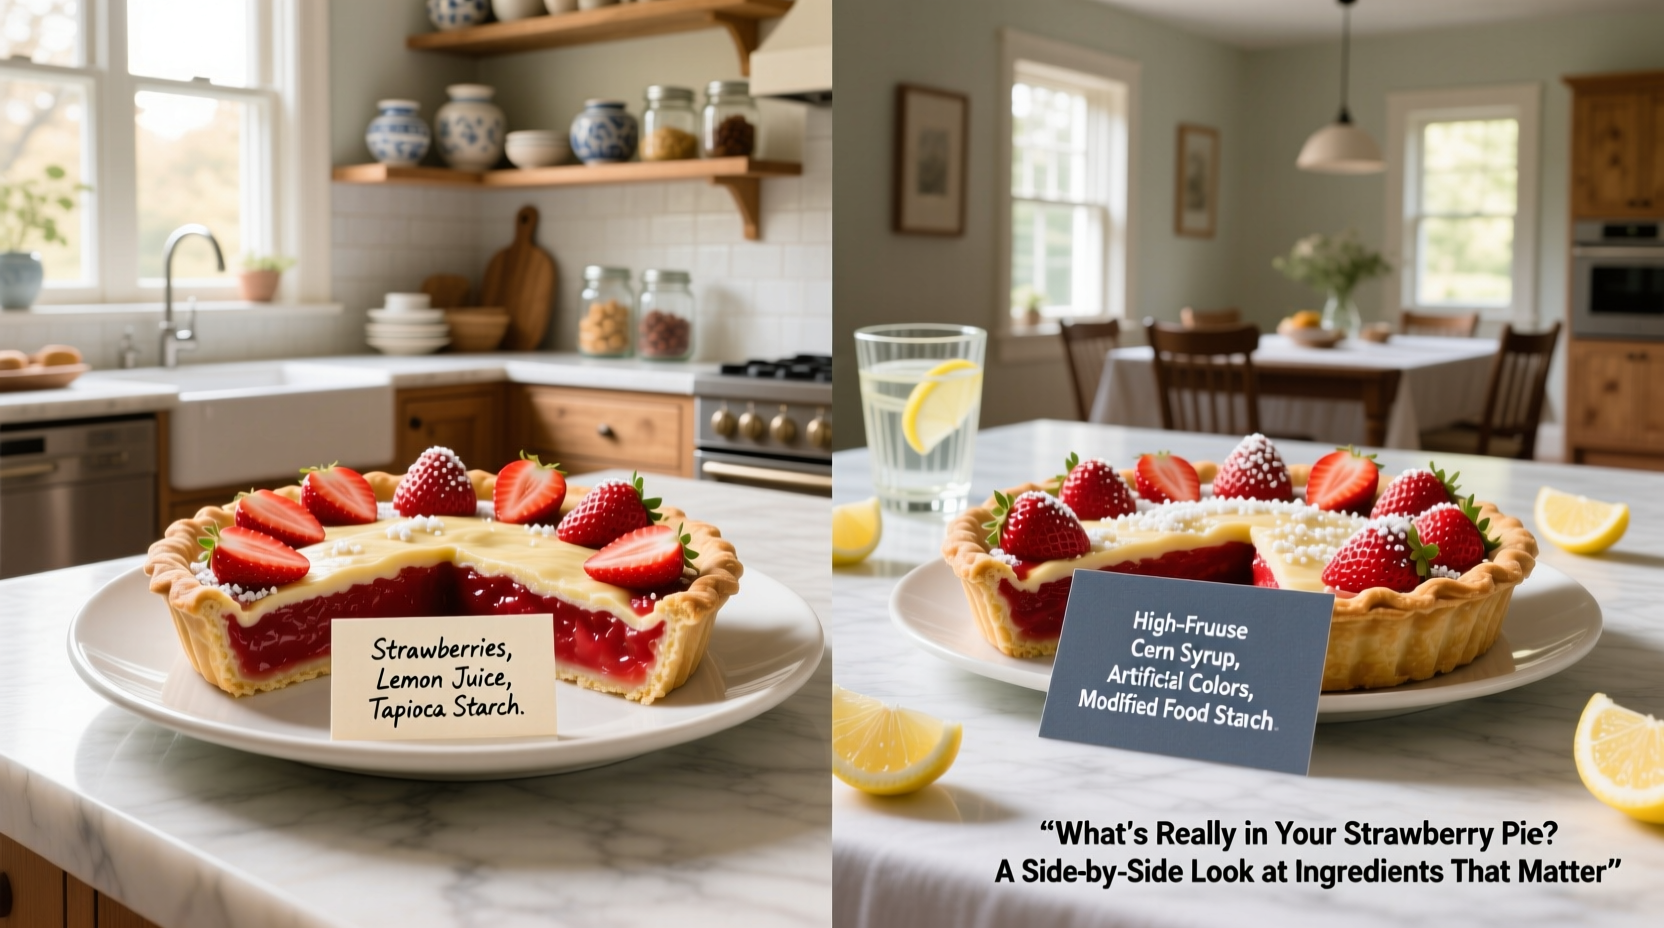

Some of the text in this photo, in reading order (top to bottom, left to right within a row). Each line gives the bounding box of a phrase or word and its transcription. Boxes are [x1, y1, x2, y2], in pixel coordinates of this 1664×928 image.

[371, 636, 512, 662] Strawberries,
[1180, 642, 1240, 672] Syrup,
[376, 666, 512, 691] Lemon Juice,
[1188, 673, 1254, 703] Colors,
[368, 693, 525, 728] Tapioca Starch.
[1163, 697, 1210, 723] Food
